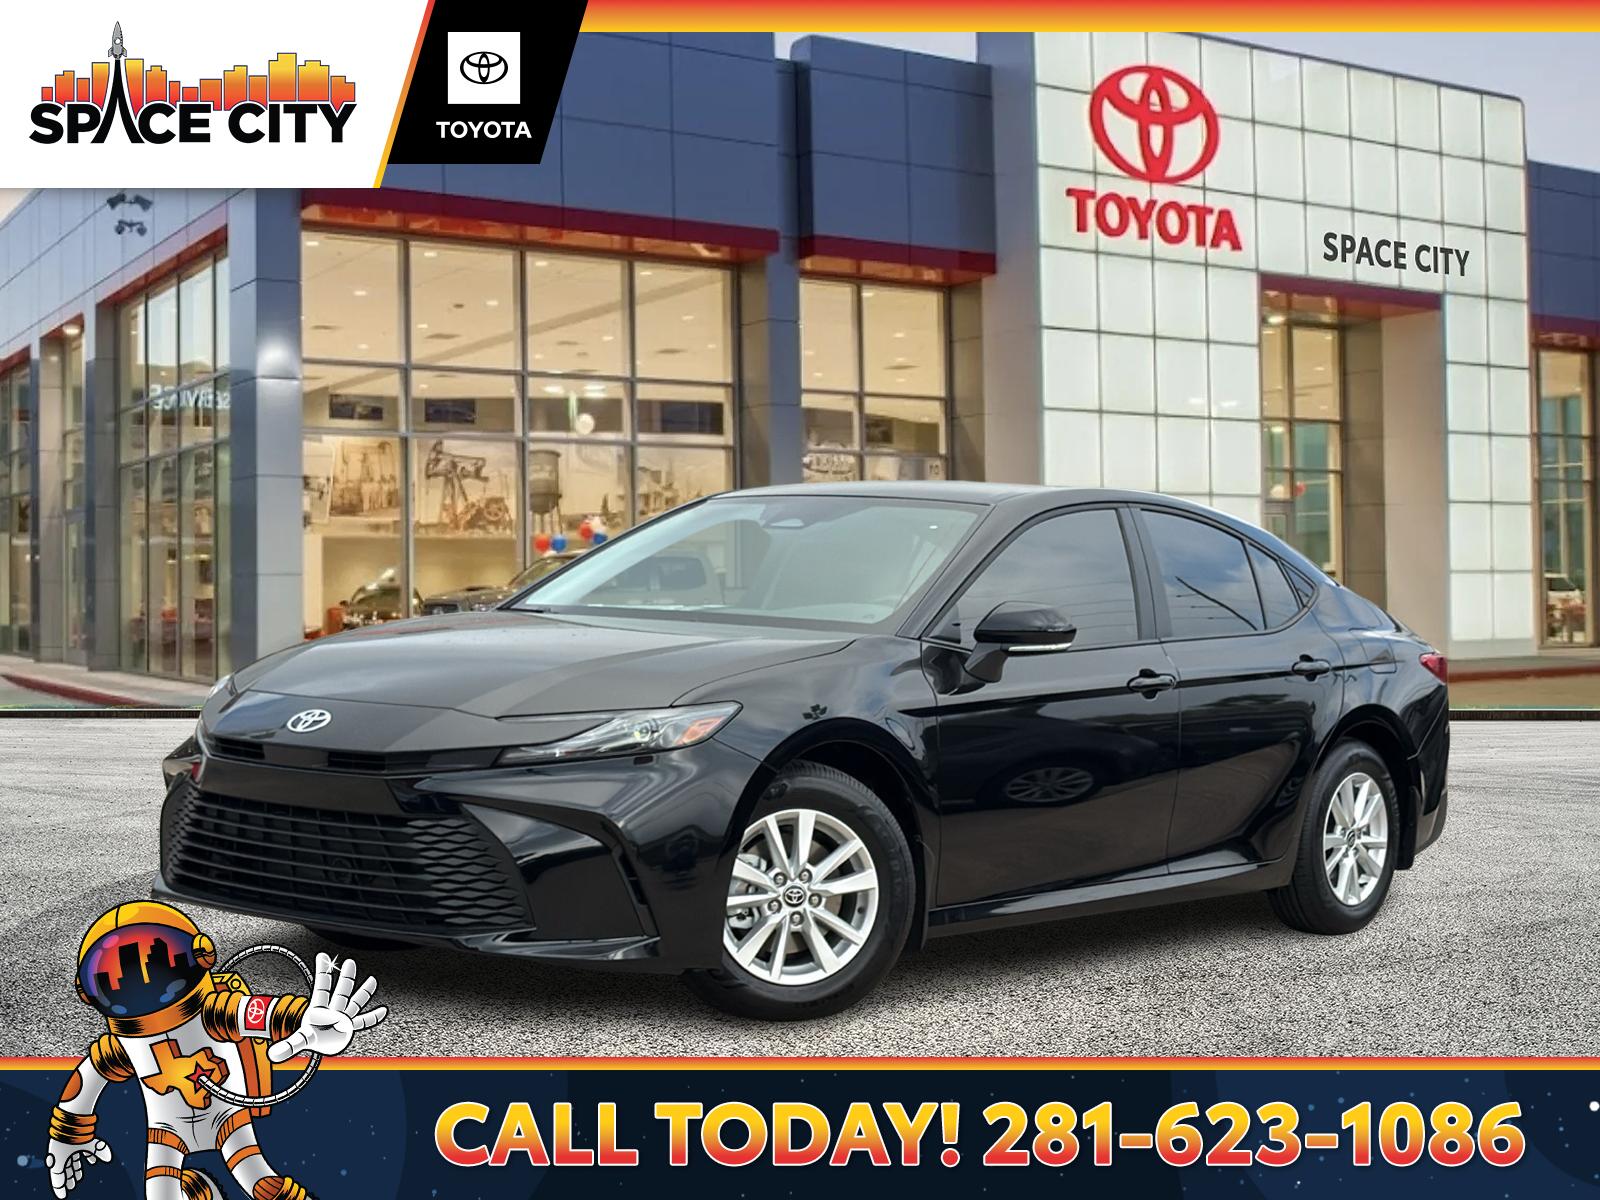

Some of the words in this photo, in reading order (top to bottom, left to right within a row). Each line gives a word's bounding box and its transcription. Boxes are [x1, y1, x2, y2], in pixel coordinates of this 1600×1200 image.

[1066, 187, 1242, 251] TOYOTA
[1323, 232, 1407, 269] SPACE
[1415, 241, 1470, 276] CITY
